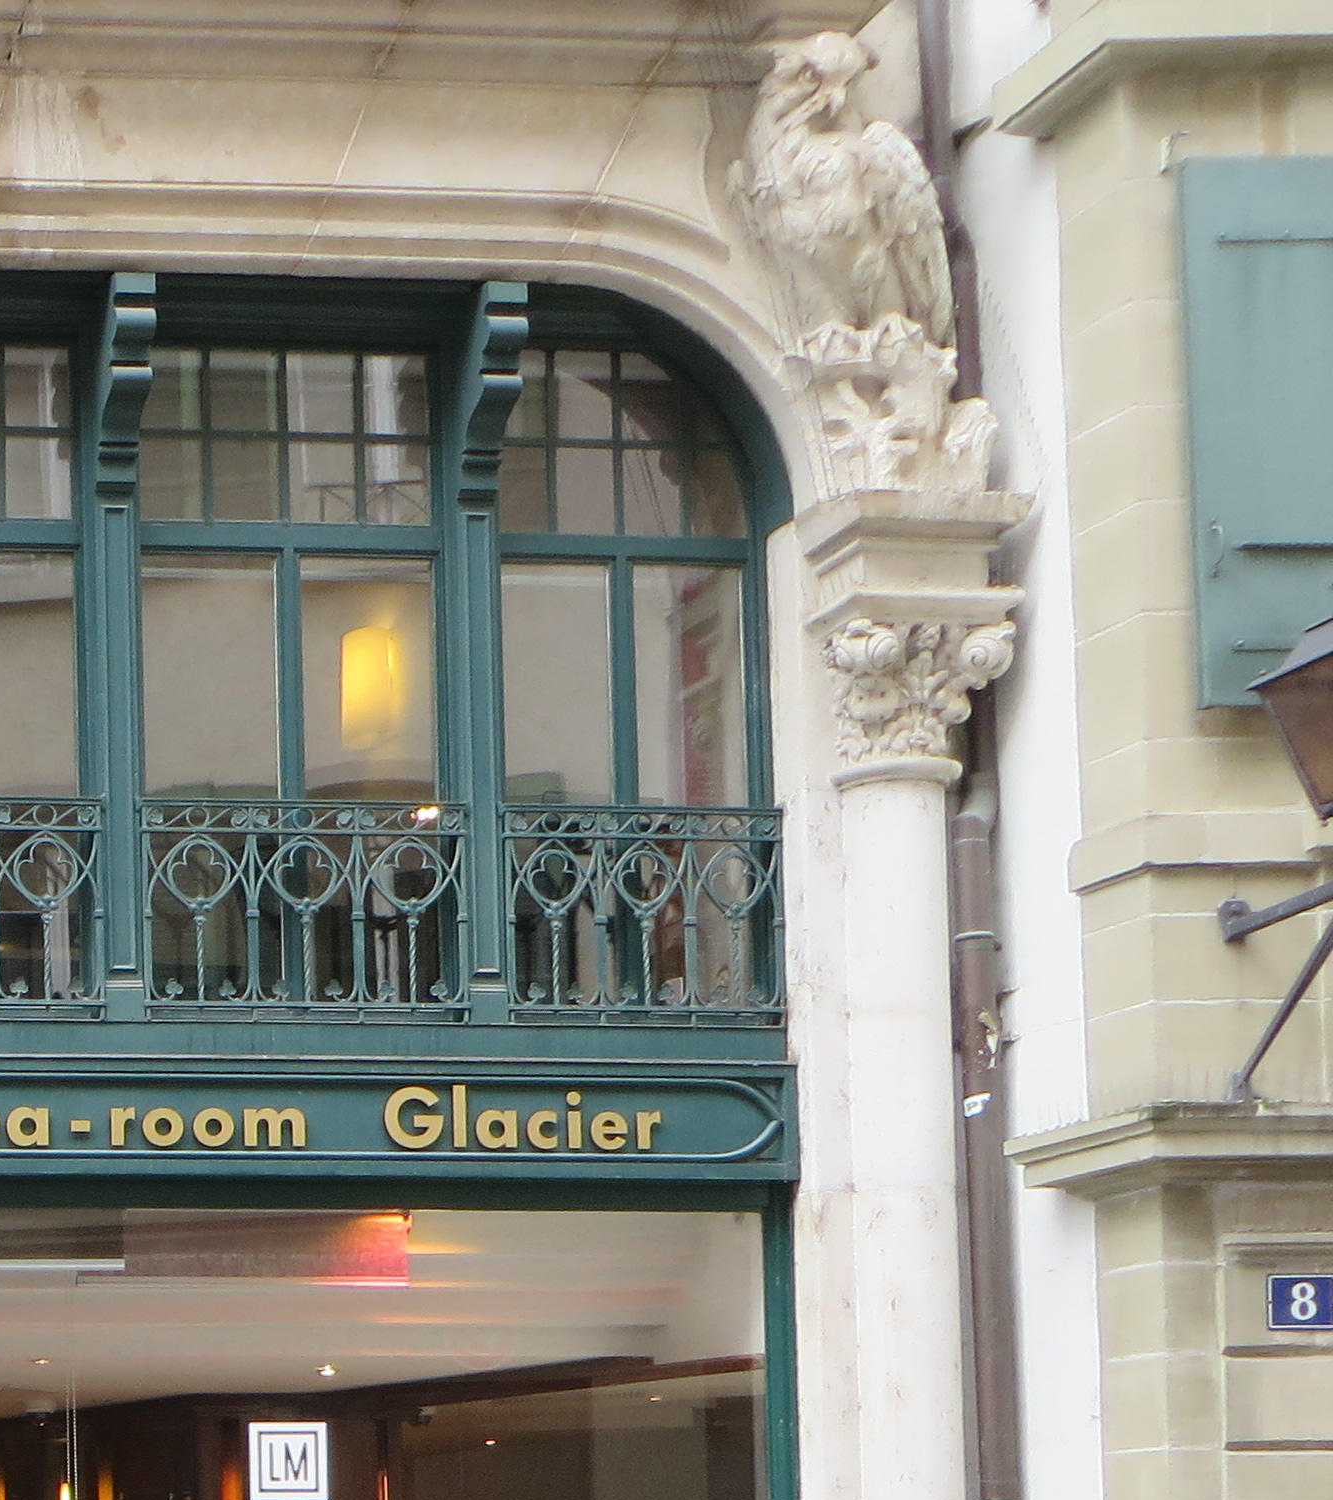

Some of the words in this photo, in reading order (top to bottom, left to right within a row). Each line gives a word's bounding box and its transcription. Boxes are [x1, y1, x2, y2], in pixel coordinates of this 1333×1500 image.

[383, 1084, 662, 1150] Glacier
[1290, 1282, 1318, 1321] 8
[269, 1441, 308, 1482] LM
